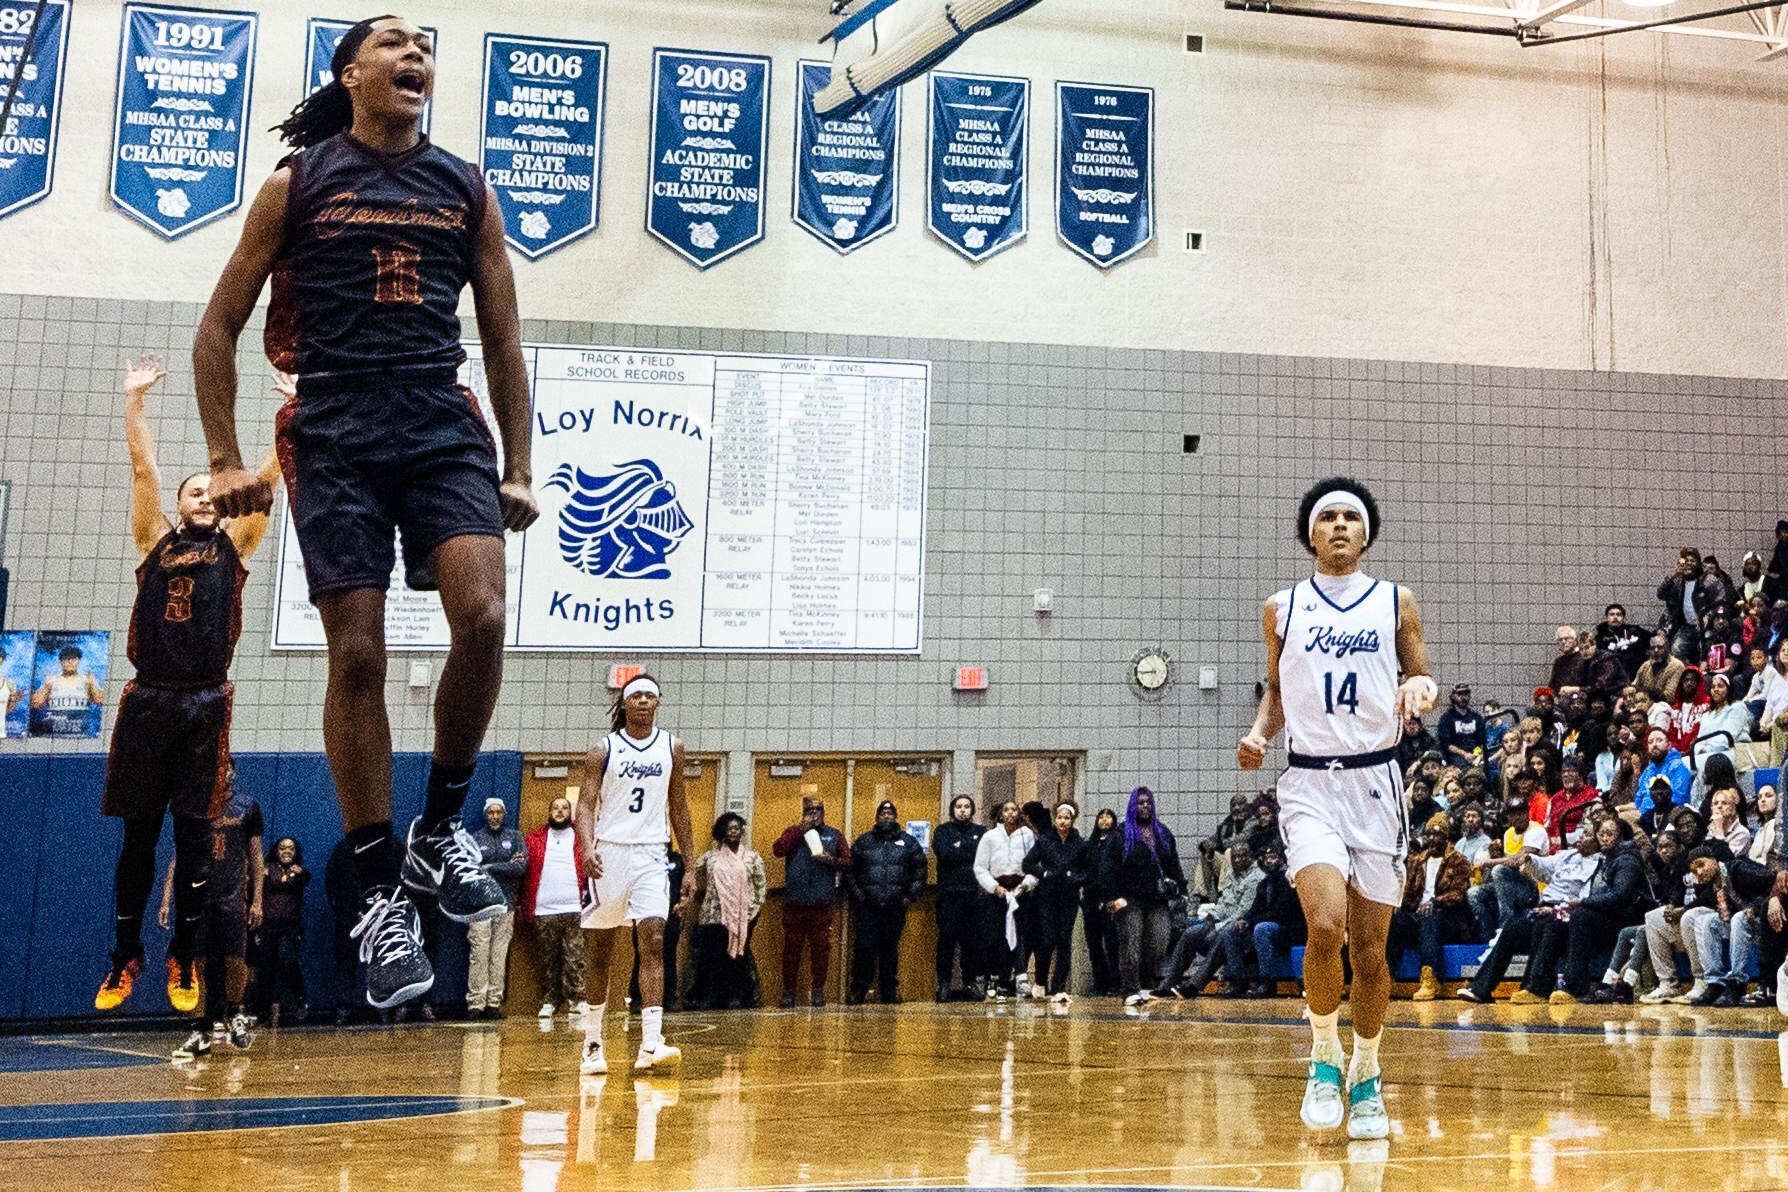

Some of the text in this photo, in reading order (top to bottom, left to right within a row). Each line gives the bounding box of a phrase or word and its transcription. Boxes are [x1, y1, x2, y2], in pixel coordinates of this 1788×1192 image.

[153, 22, 224, 51] 1991
[135, 56, 238, 79] WOMEN'S
[509, 50, 582, 78] 2006
[145, 74, 226, 95] TENNIS
[677, 64, 747, 92] 2008
[512, 86, 575, 105] MEN'S
[36, 105, 47, 118] A
[495, 100, 590, 122] BOWLING
[680, 99, 741, 117] MEN'S
[125, 111, 235, 131] MHSAA CLASS A
[683, 116, 735, 133] GOLF
[824, 121, 873, 134] CLASS A
[958, 119, 1000, 131] MHSAA
[150, 129, 209, 147] STATE
[817, 133, 880, 147] REGIONAL
[955, 131, 1003, 144] CLASS A
[1085, 128, 1126, 141] MHSAA
[486, 137, 593, 156] MHSAA DIVISION 2
[812, 147, 885, 160] CHAMPIONS
[949, 143, 1009, 157] REGIONAL
[1082, 141, 1129, 153] CLASS A
[120, 144, 235, 168] CHAMPIONS
[512, 155, 566, 172] STATE
[661, 150, 753, 169] ACADEMIC
[943, 156, 1013, 169] CHAMPIONS
[1075, 152, 1134, 166] REGIONAL
[485, 169, 590, 191] CHAMPIONS
[681, 167, 733, 184] STATE
[1072, 166, 1139, 178] CHAMPIONS
[654, 182, 758, 202] CHAMPIONS
[821, 195, 872, 206] WOMEN'S
[977, 205, 1011, 216] CROSS
[1079, 211, 1129, 224] SOFTBALL
[951, 214, 1001, 225] COUNTRY
[580, 353, 674, 366] TRACK & FIELD
[567, 367, 685, 381] SCHOOL RECORDS
[538, 408, 594, 435] Loy
[549, 590, 674, 631] Knights
[1305, 626, 1379, 658] Knights
[1324, 672, 1359, 715] 14
[619, 761, 662, 780] Knights
[629, 788, 644, 813] 3
